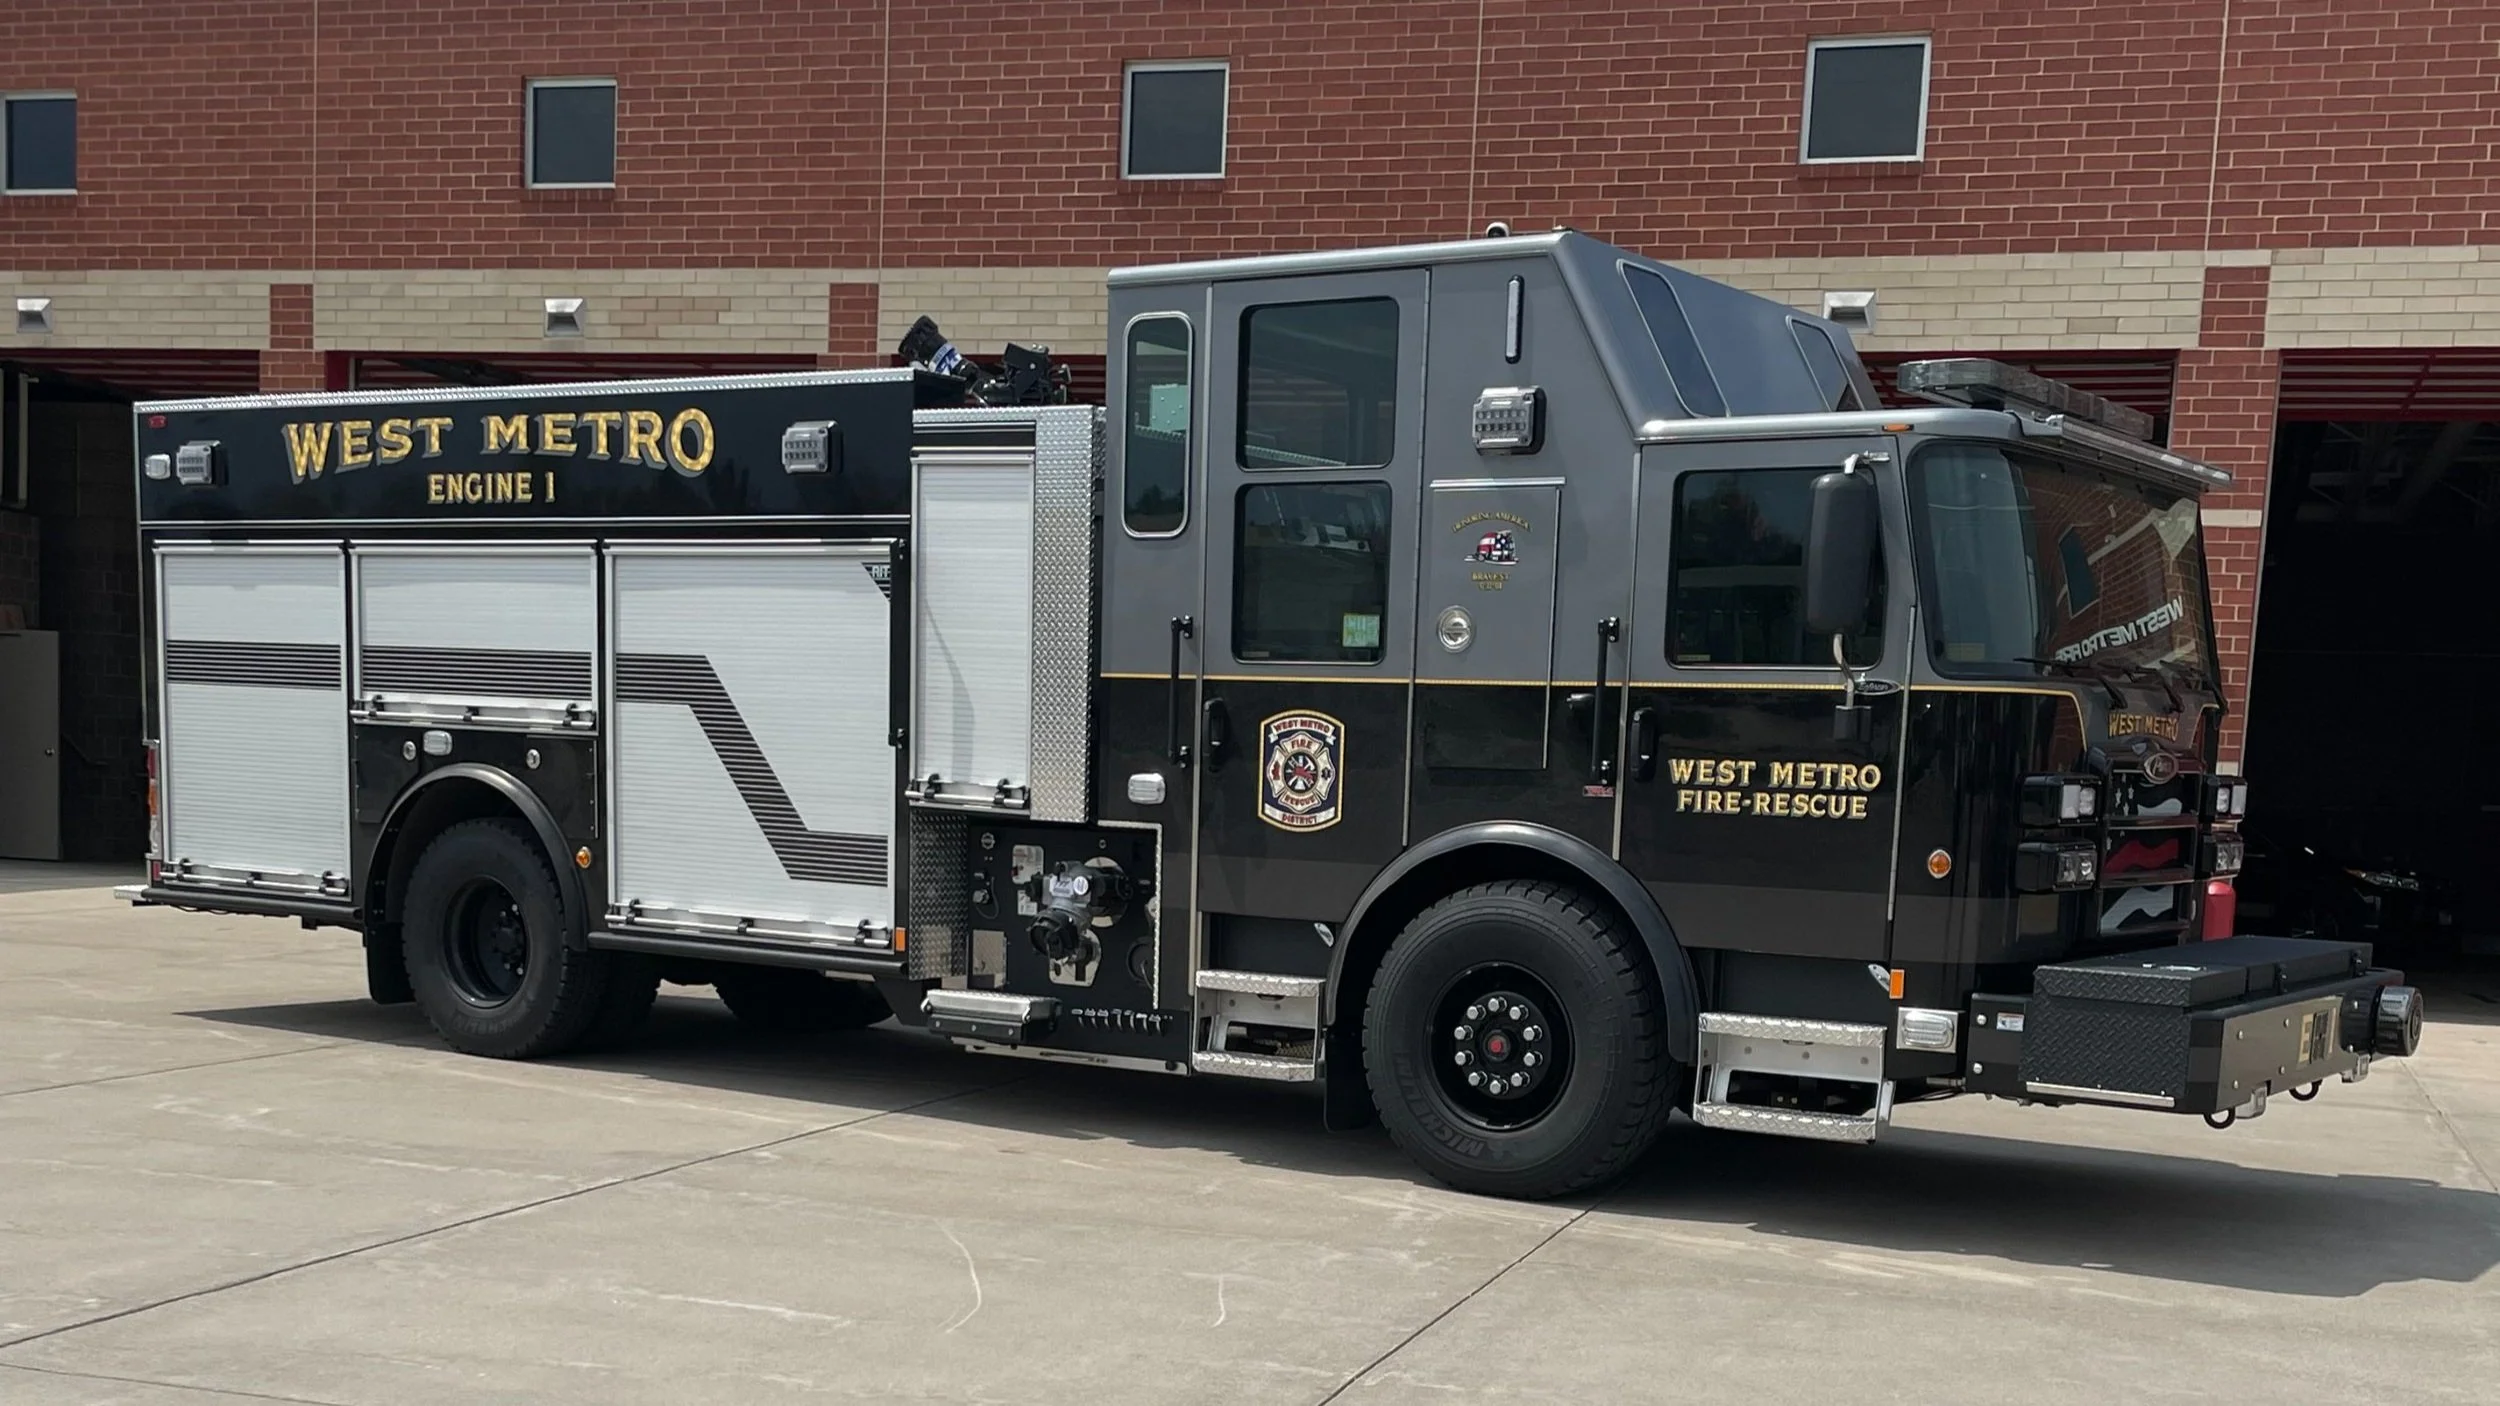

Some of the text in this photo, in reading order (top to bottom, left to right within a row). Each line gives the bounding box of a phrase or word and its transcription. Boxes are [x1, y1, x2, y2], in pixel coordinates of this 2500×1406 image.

[281, 407, 716, 485] WEST METRO
[426, 471, 556, 505] ENGINE 1
[872, 564, 890, 578] RIT
[1273, 719, 1330, 732] WEST METRO
[2107, 711, 2179, 741] WEST METRO
[1291, 739, 1313, 749] FIRE
[1668, 758, 1882, 792] WEST METRO
[1285, 795, 1315, 806] RESCUE
[1675, 788, 1869, 820] FIRE-RESCUE
[1282, 814, 1318, 824] DISTRICT
